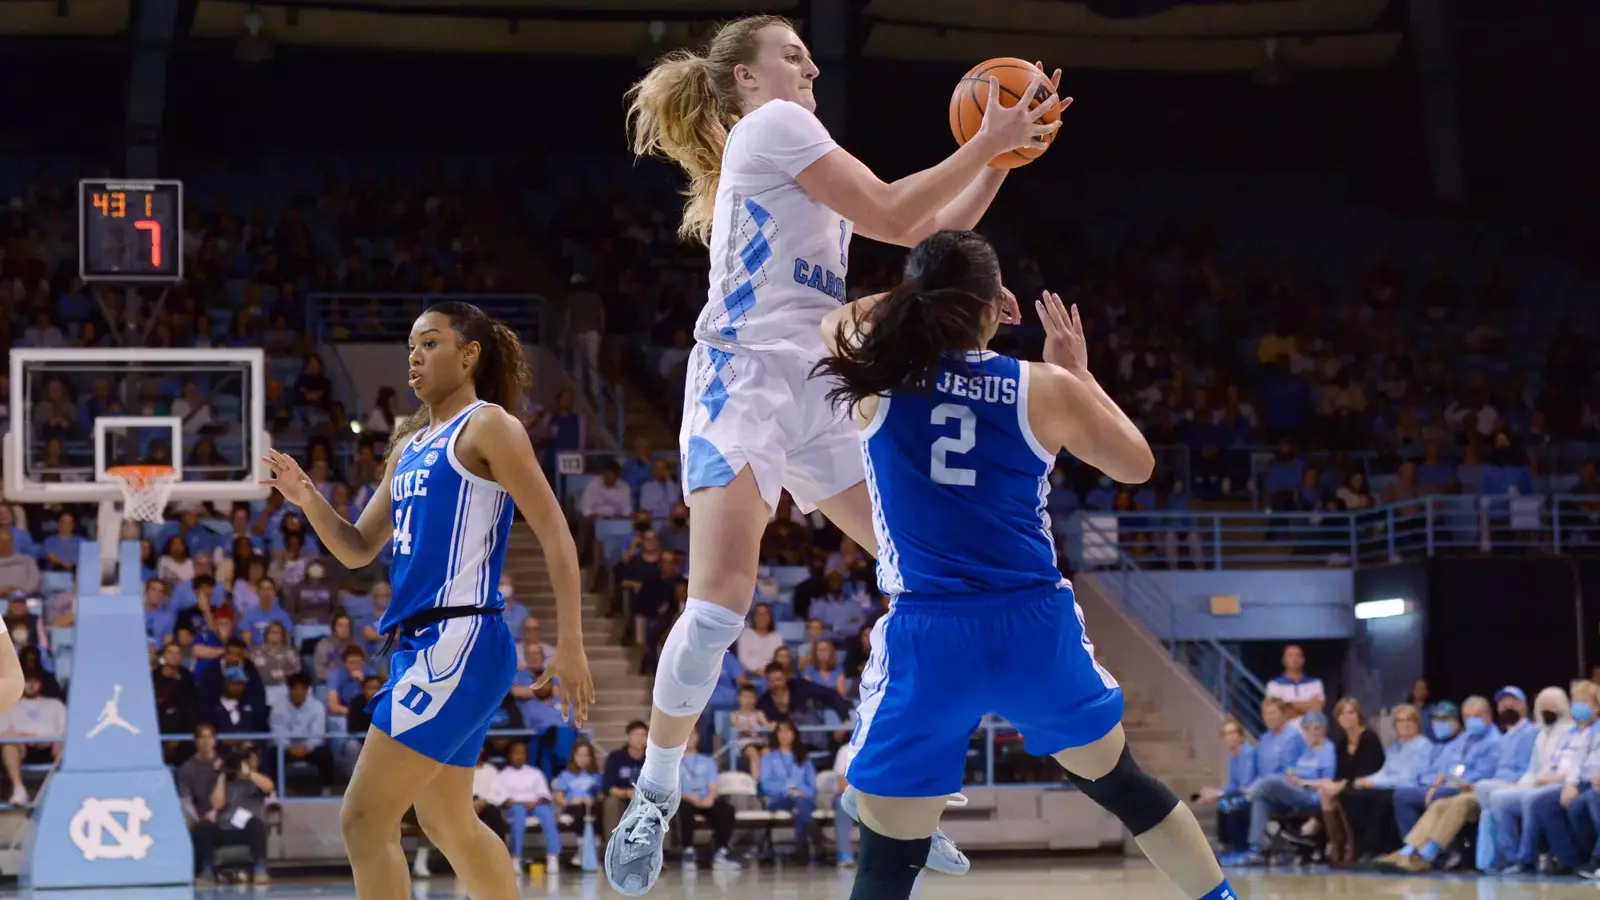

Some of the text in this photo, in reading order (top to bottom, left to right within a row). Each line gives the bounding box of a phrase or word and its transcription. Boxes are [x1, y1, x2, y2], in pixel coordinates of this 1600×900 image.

[134, 220, 161, 268] 7
[793, 257, 846, 306] CARO
[936, 371, 1017, 405] JESUS
[930, 402, 977, 487] 2
[390, 469, 430, 502] UKE
